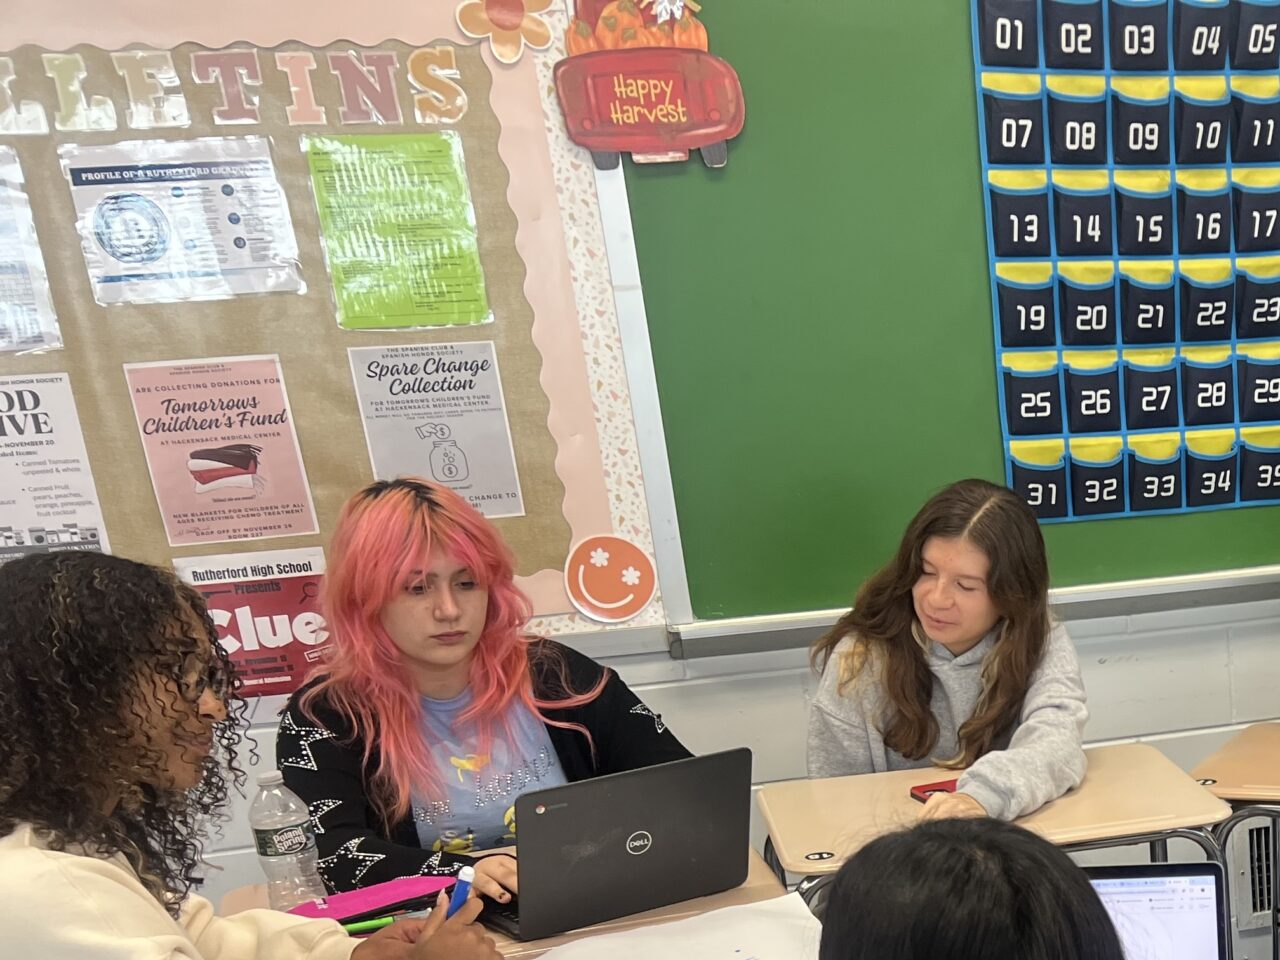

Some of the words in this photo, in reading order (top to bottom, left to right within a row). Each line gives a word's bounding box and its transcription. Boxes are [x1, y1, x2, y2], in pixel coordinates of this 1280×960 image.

[996, 18, 1022, 50] 01
[1062, 23, 1091, 53] 02
[1125, 25, 1154, 54] 03
[1192, 26, 1220, 54] 04
[1249, 24, 1277, 53] 05
[614, 74, 673, 105] Happy
[610, 99, 687, 125] Harvest
[1002, 119, 1032, 147] 07
[1066, 122, 1095, 149] 08
[1129, 123, 1158, 149] 09
[1197, 122, 1220, 149] 10
[1254, 120, 1274, 146] 11
[81, 171, 121, 180] PROFILE
[1010, 215, 1037, 241] 13
[1074, 215, 1100, 242] 14
[1136, 216, 1162, 241] 15
[1197, 213, 1221, 239] 16
[1253, 210, 1277, 237] 17
[1017, 306, 1044, 330] 19
[1077, 306, 1106, 329] 20
[1138, 305, 1163, 327] 21
[1197, 302, 1226, 325] 22
[1253, 297, 1280, 321] 23
[366, 360, 420, 381] Spare
[423, 357, 491, 376] Change
[155, 383, 208, 392] COLLECTING
[211, 379, 261, 388] DONATIONS
[390, 376, 476, 395] Collection
[161, 396, 260, 415] Tomorrows
[1021, 392, 1050, 417] 25
[1081, 389, 1110, 414] 26
[1142, 386, 1170, 411] 27
[1198, 382, 1225, 407] 28
[143, 413, 234, 435] Children's
[236, 409, 288, 428] Fund
[469, 493, 502, 501] CHANGE
[1028, 484, 1056, 504] 31
[1086, 479, 1116, 502] 32
[1144, 476, 1174, 497] 33
[1201, 470, 1230, 493] 34
[192, 566, 248, 581] Rutherford
[250, 564, 274, 577] High
[276, 561, 312, 574] School
[234, 581, 281, 594] Presents
[207, 606, 330, 654] Clue
[273, 826, 303, 844] Poland
[276, 835, 306, 852] Spring
[629, 838, 649, 848] DELL
